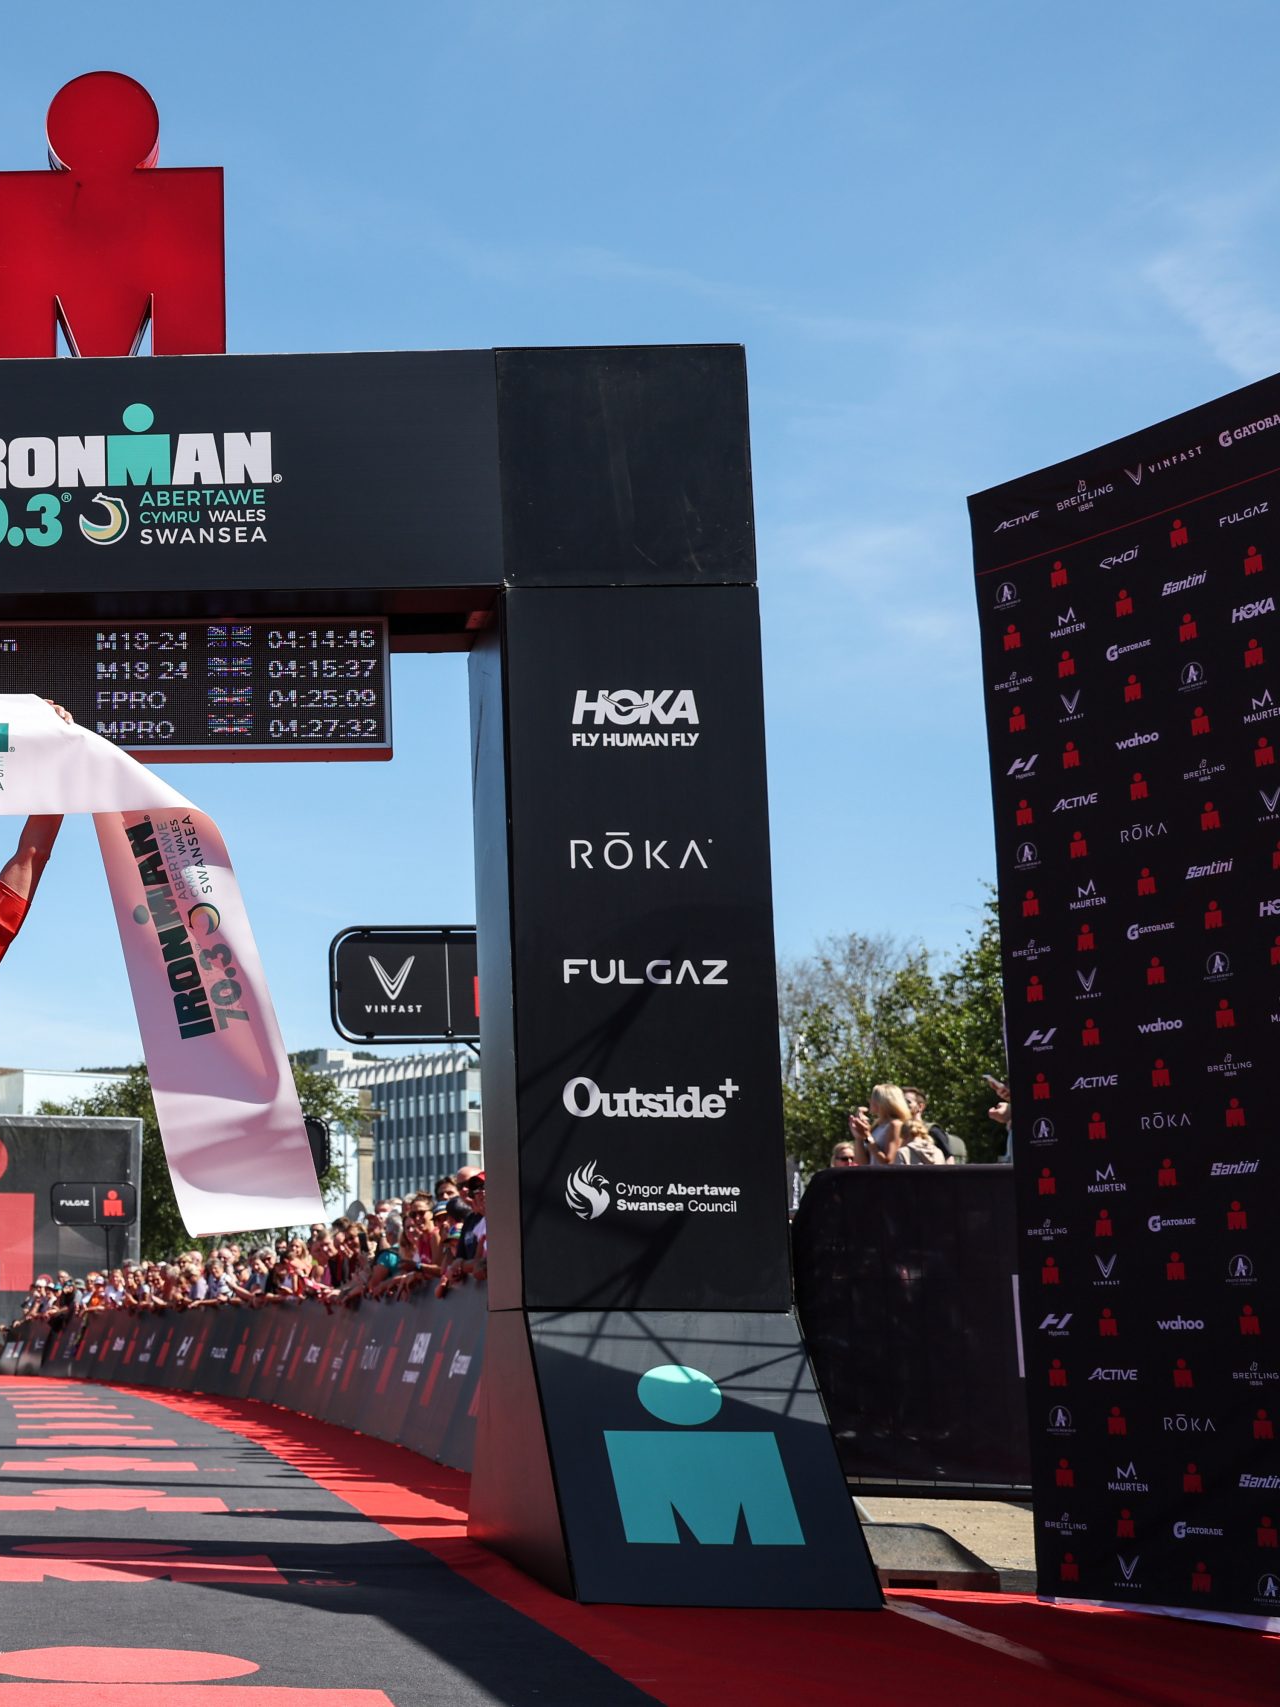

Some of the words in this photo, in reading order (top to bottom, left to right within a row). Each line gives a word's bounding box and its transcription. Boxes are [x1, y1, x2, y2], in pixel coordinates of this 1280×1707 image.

[139, 489, 266, 508] ABERTAWE
[993, 510, 1040, 533] ACTIVE
[1056, 483, 1114, 512] BREITLING
[1148, 445, 1203, 474] VINFAST
[139, 510, 201, 525] CYMRU
[207, 508, 267, 523] WALES
[1219, 502, 1269, 528] FULGAZ
[139, 526, 267, 545] SWANSEA
[1161, 570, 1207, 597] Santini
[1231, 597, 1276, 624] HOKA
[268, 630, 376, 649] 04:14:46
[1050, 621, 1086, 639] MAURTEN
[1118, 639, 1151, 655] GATORADE
[268, 660, 377, 679] 04:15:37
[994, 676, 1033, 691] BREITLING
[96, 691, 167, 709] FPRO
[268, 689, 377, 708] 04:25:09
[571, 689, 700, 725] HOKA
[96, 720, 175, 739] MPRO
[268, 718, 377, 738] 04:27:32
[571, 732, 600, 747] FLY
[602, 732, 669, 747] HUMAN
[671, 732, 700, 747] FLY
[1115, 731, 1160, 751] wahoo
[1183, 764, 1226, 780] BREITLING
[1052, 792, 1098, 813] ACTIVE
[170, 818, 186, 856] WALES
[156, 821, 189, 900] ABERTAWE
[181, 814, 213, 894] SWANSEA
[1185, 858, 1234, 880] Santini
[1069, 896, 1107, 911] MAURTEN
[126, 820, 216, 1040] IRONMAN
[1012, 945, 1051, 958] BREITLING
[563, 958, 729, 986] FULGAZ
[364, 1004, 423, 1013] VINFAST
[1137, 1017, 1183, 1035] wahoo
[1207, 1061, 1253, 1073] BREITLING
[1070, 1074, 1119, 1090] ACTIVE
[1087, 1182, 1127, 1193] MAURTEN
[1209, 1159, 1260, 1176] Santini
[615, 1182, 663, 1198] Cyngor
[666, 1182, 741, 1196] Abertawe
[616, 1198, 684, 1212] Swansea
[687, 1200, 738, 1213] Council
[1027, 1227, 1068, 1237] BREITLING
[1156, 1315, 1205, 1331] wahoo
[1088, 1367, 1138, 1381] ACTIVE
[1232, 1371, 1280, 1380] BREITLING
[1107, 1481, 1149, 1493] MAURTEN
[1044, 1519, 1088, 1531] BREITLING
[1186, 1526, 1224, 1537] GATORADE
